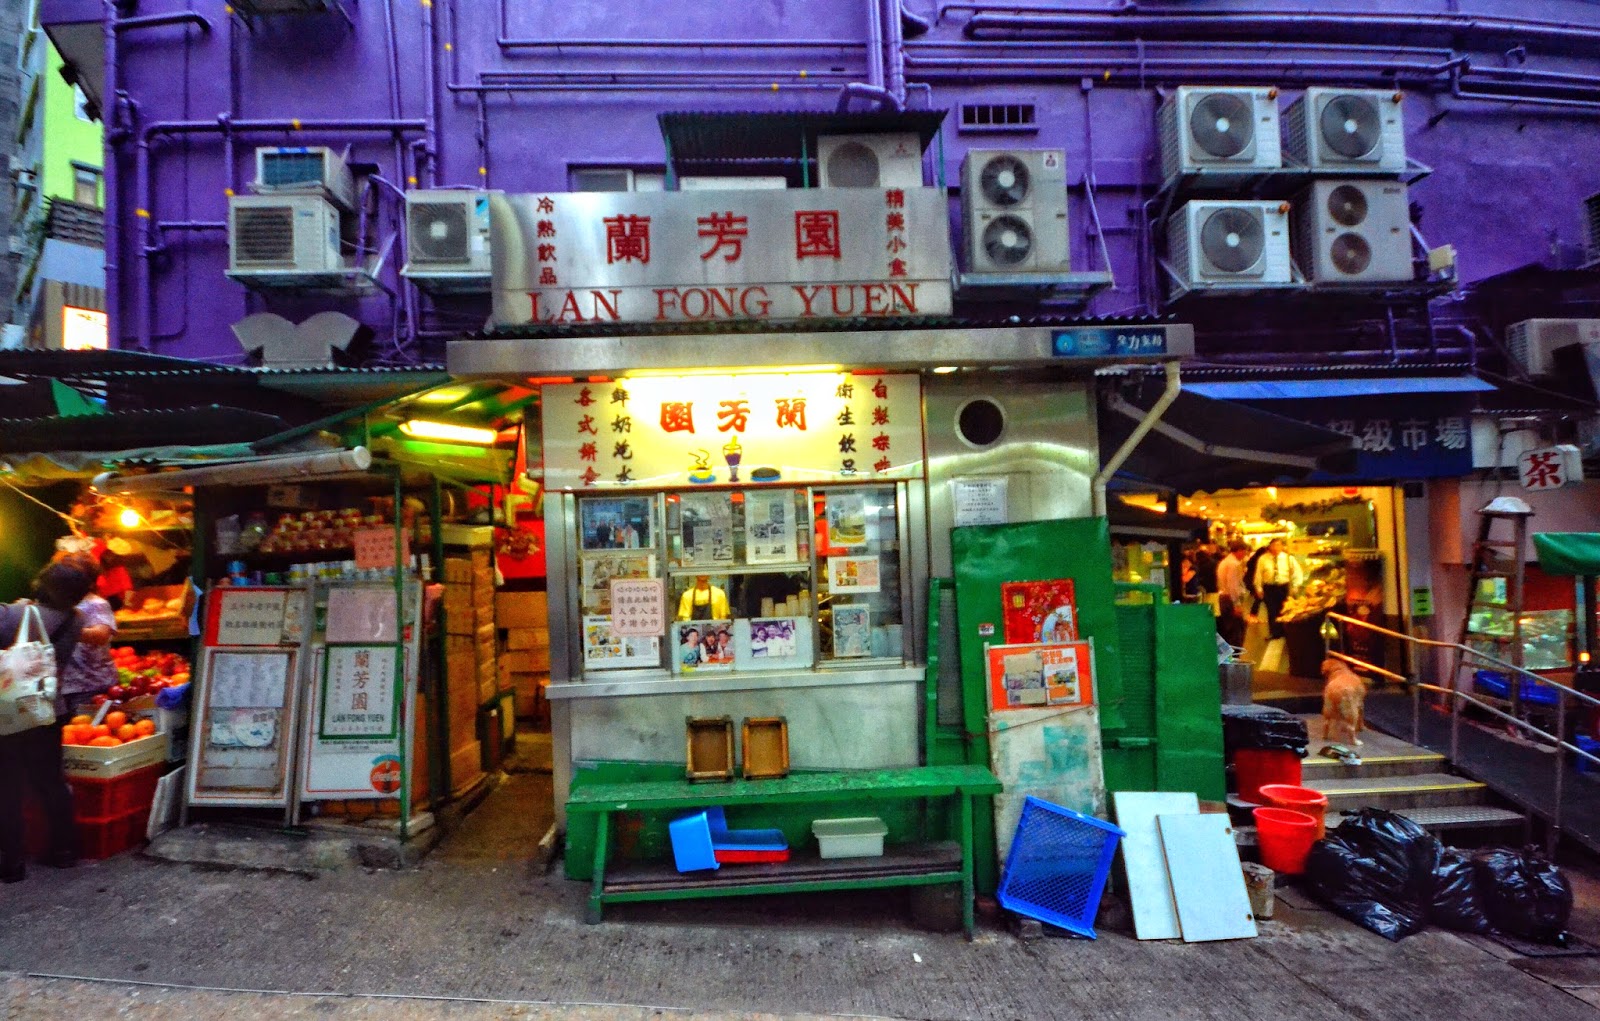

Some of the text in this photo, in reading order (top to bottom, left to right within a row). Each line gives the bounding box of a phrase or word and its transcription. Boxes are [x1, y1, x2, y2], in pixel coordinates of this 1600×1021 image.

[536, 195, 558, 285] 冷熱飲品
[603, 209, 842, 265] 蘭芳園
[885, 188, 908, 277] 精美小食
[528, 282, 919, 325] LAN FONG YUEN
[659, 397, 808, 434] 蘭芳園
[835, 383, 857, 476] 衛生飲品
[1524, 452, 1561, 488] 茶
[352, 649, 370, 711] 蘭芳園
[332, 714, 346, 723] LAN
